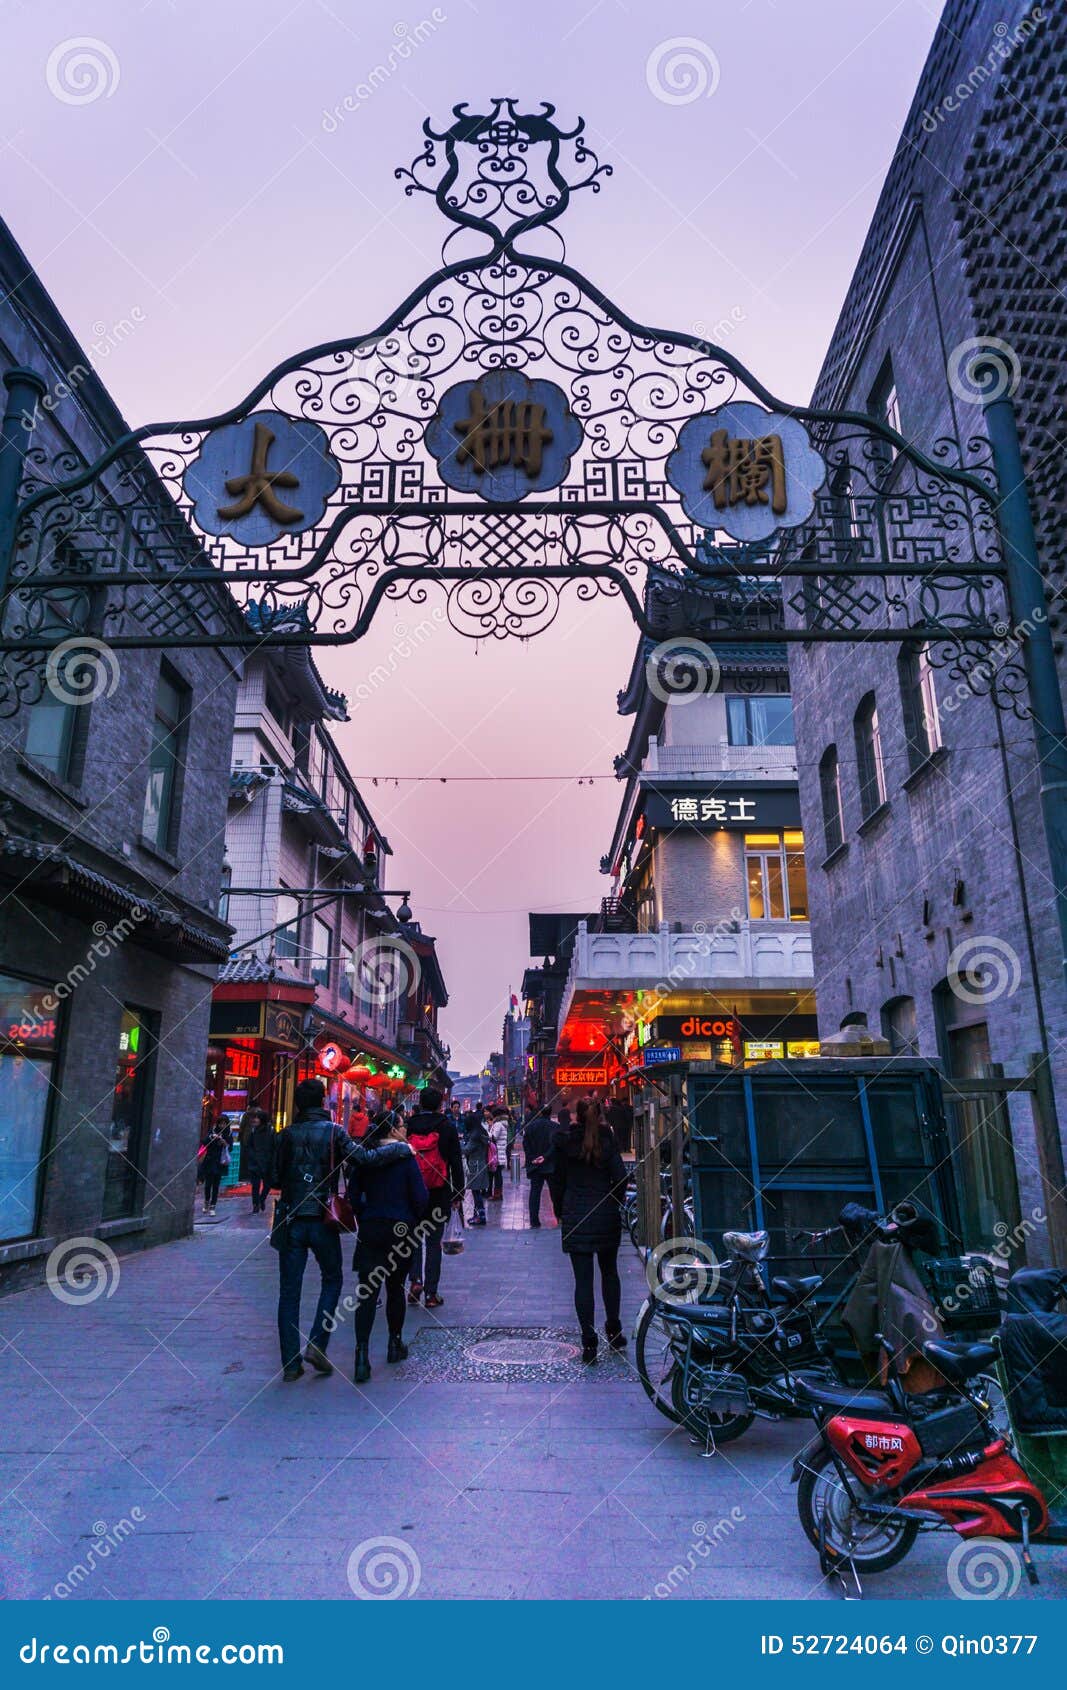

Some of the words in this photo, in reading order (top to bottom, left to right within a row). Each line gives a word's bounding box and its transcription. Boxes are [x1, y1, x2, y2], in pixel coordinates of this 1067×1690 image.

[217, 423, 304, 524] 大
[671, 797, 756, 821] 德克士
[681, 1017, 734, 1037] dicos
[865, 1434, 904, 1452] 都市风
